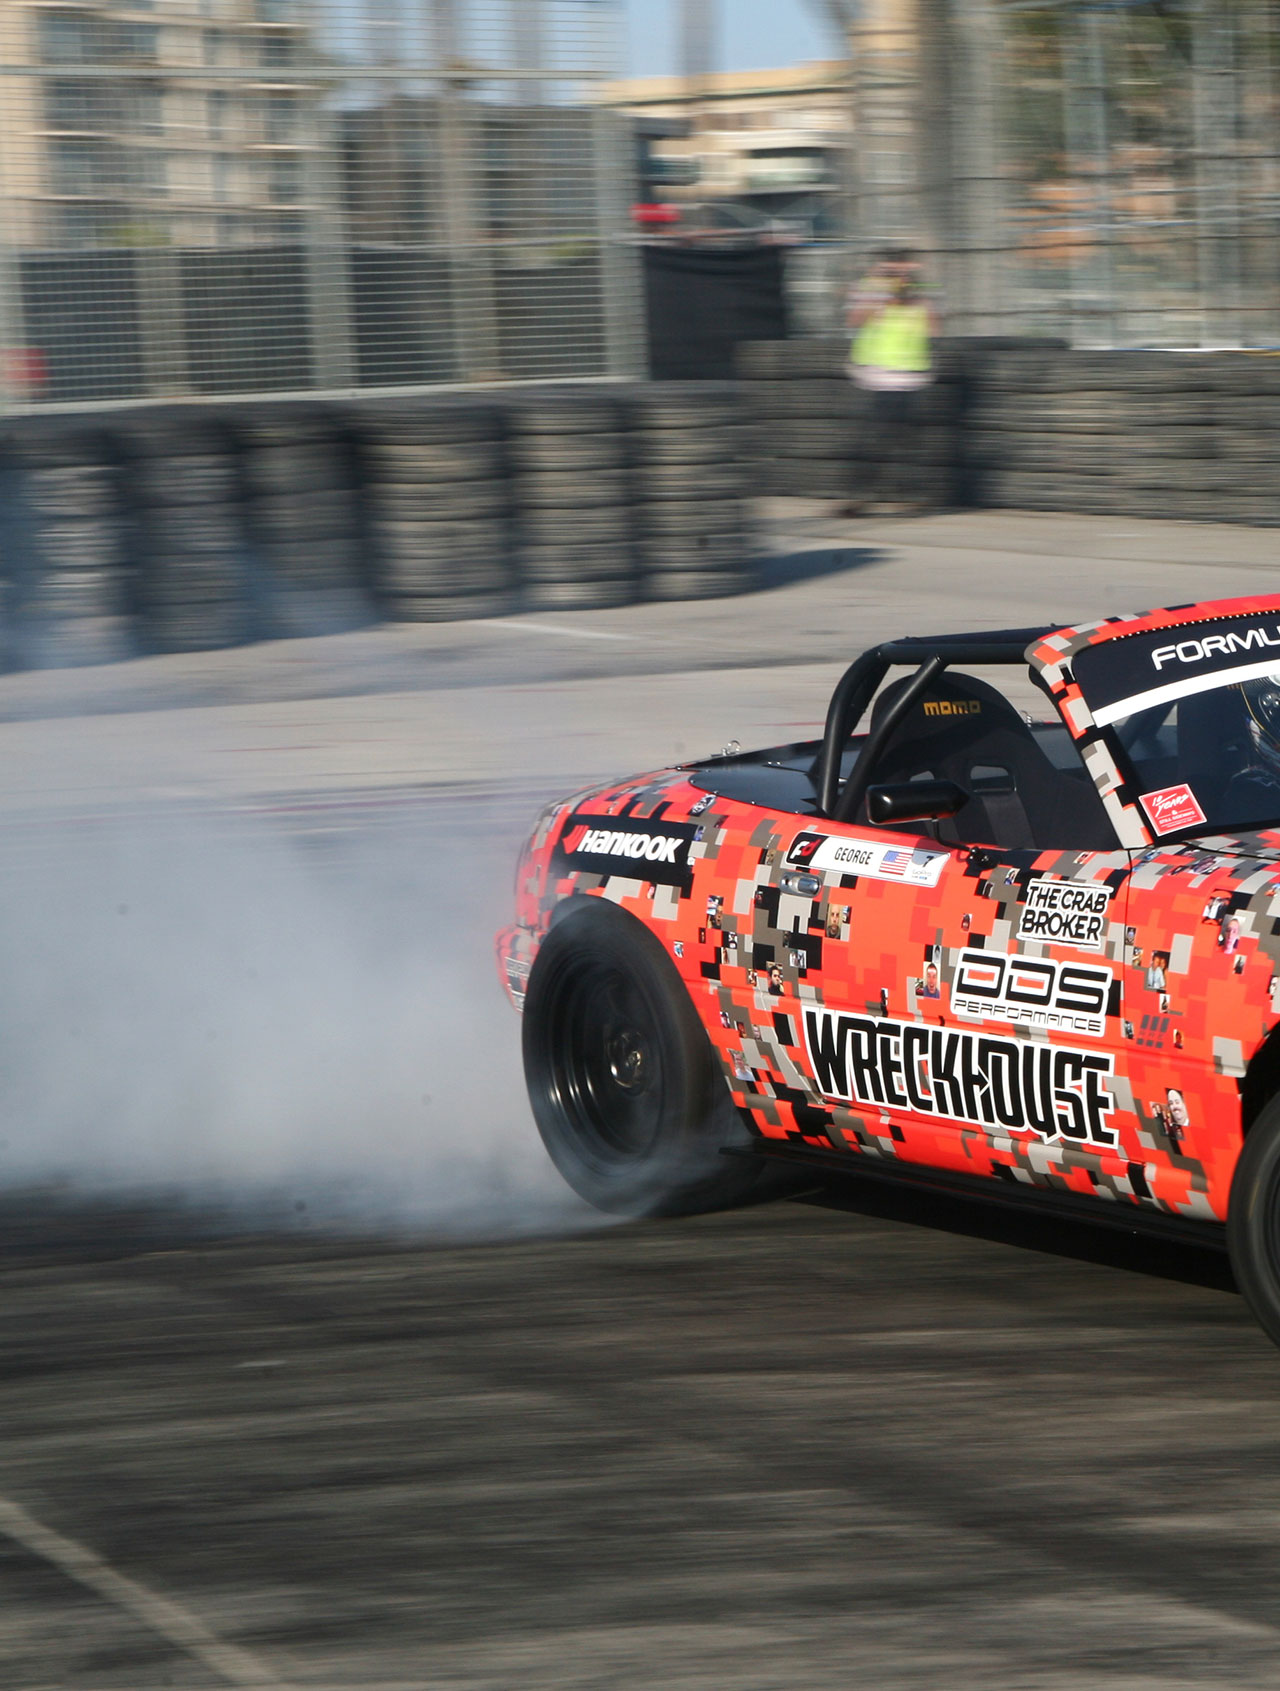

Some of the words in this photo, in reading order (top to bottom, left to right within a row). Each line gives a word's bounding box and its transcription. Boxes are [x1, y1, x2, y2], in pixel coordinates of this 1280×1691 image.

[834, 847, 874, 865] GEORGE
[1028, 886, 1062, 909] THE
[1061, 890, 1108, 914] CRAB
[1022, 909, 1102, 941] BROKER
[953, 999, 1102, 1032] PERFORMANCE
[806, 1011, 1115, 1145] WRECKHOUSE
